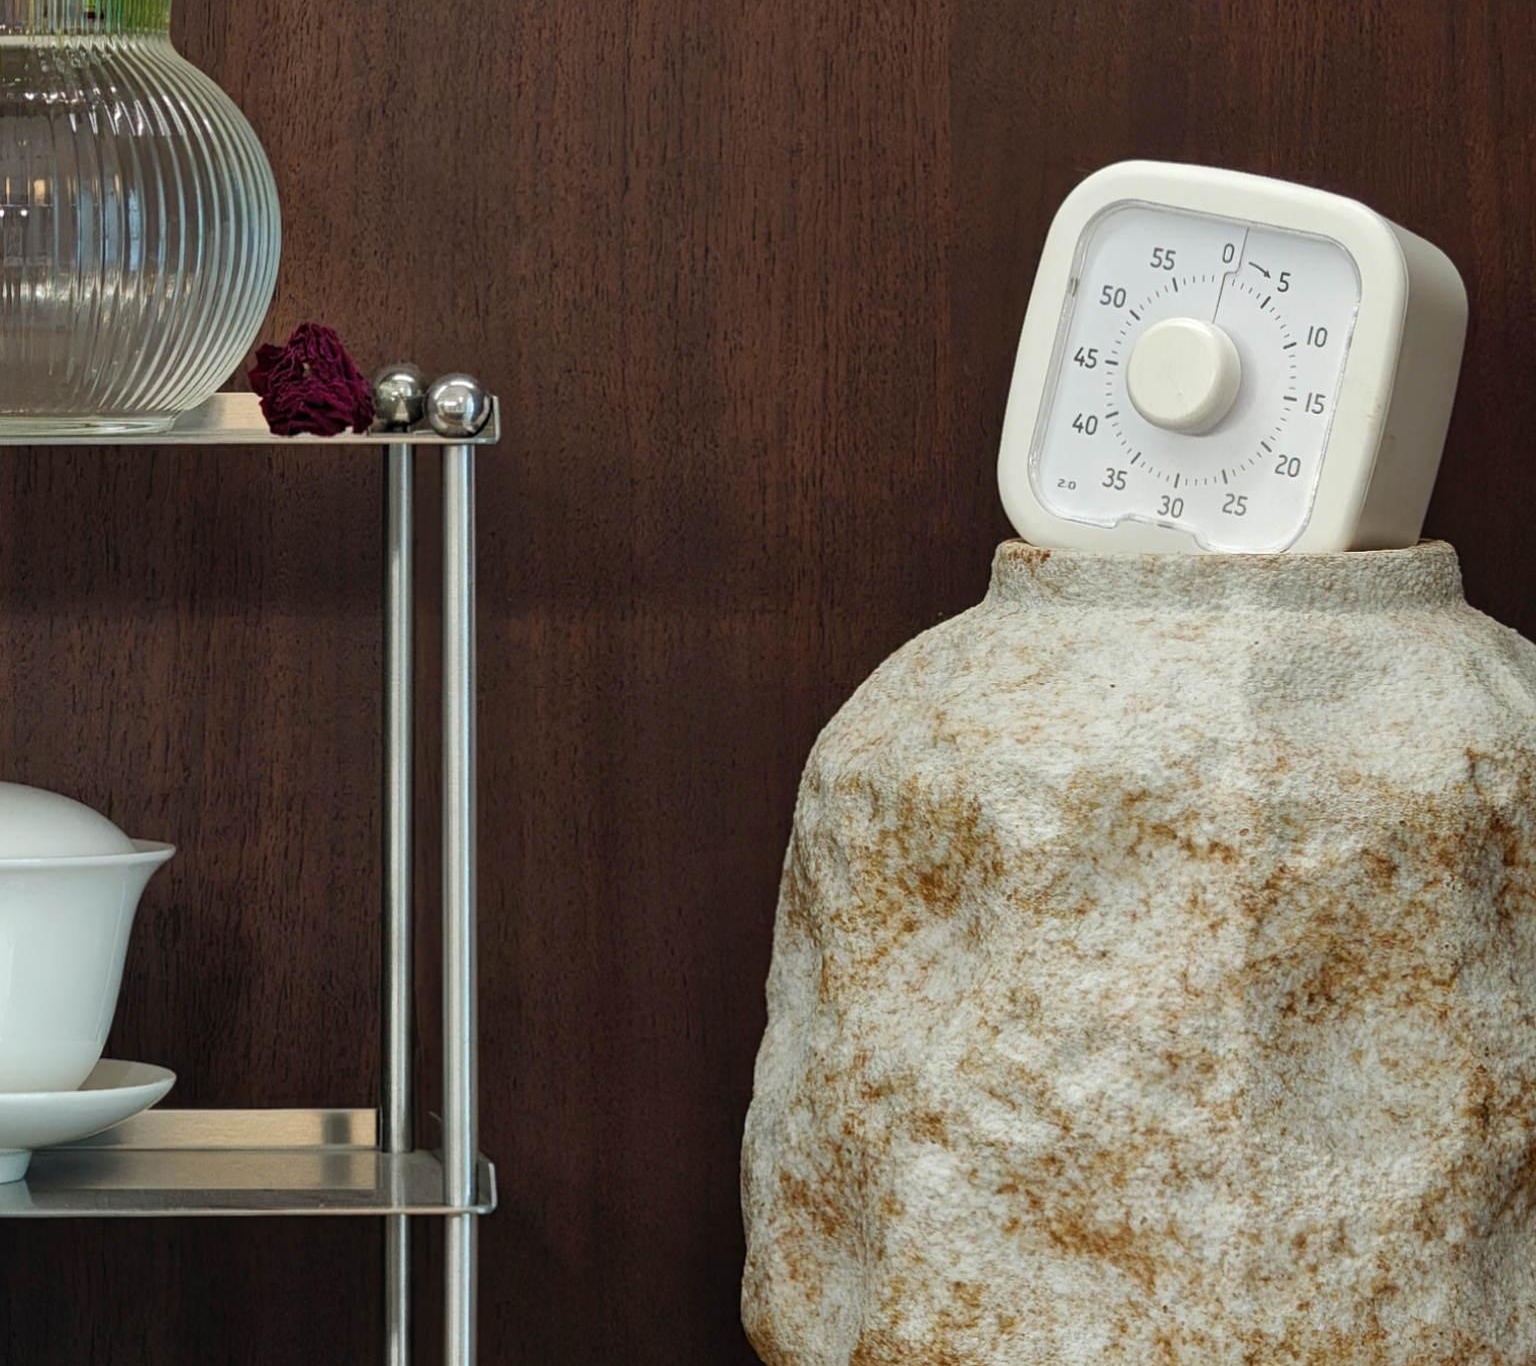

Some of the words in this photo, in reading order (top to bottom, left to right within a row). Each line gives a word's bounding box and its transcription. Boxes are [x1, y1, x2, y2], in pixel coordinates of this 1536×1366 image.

[1150, 248, 1176, 270] 55
[1222, 243, 1234, 263] 0
[1277, 272, 1291, 292] 5
[1100, 285, 1126, 308] 50
[1307, 326, 1328, 347] 10
[1074, 347, 1097, 369] 45
[1305, 393, 1325, 414] 15
[1072, 414, 1097, 435] 40
[1275, 455, 1300, 478] 20
[1057, 478, 1076, 490] 2.0
[1102, 468, 1127, 490] 35
[1157, 496, 1184, 518] 30
[1222, 493, 1248, 516] 25
